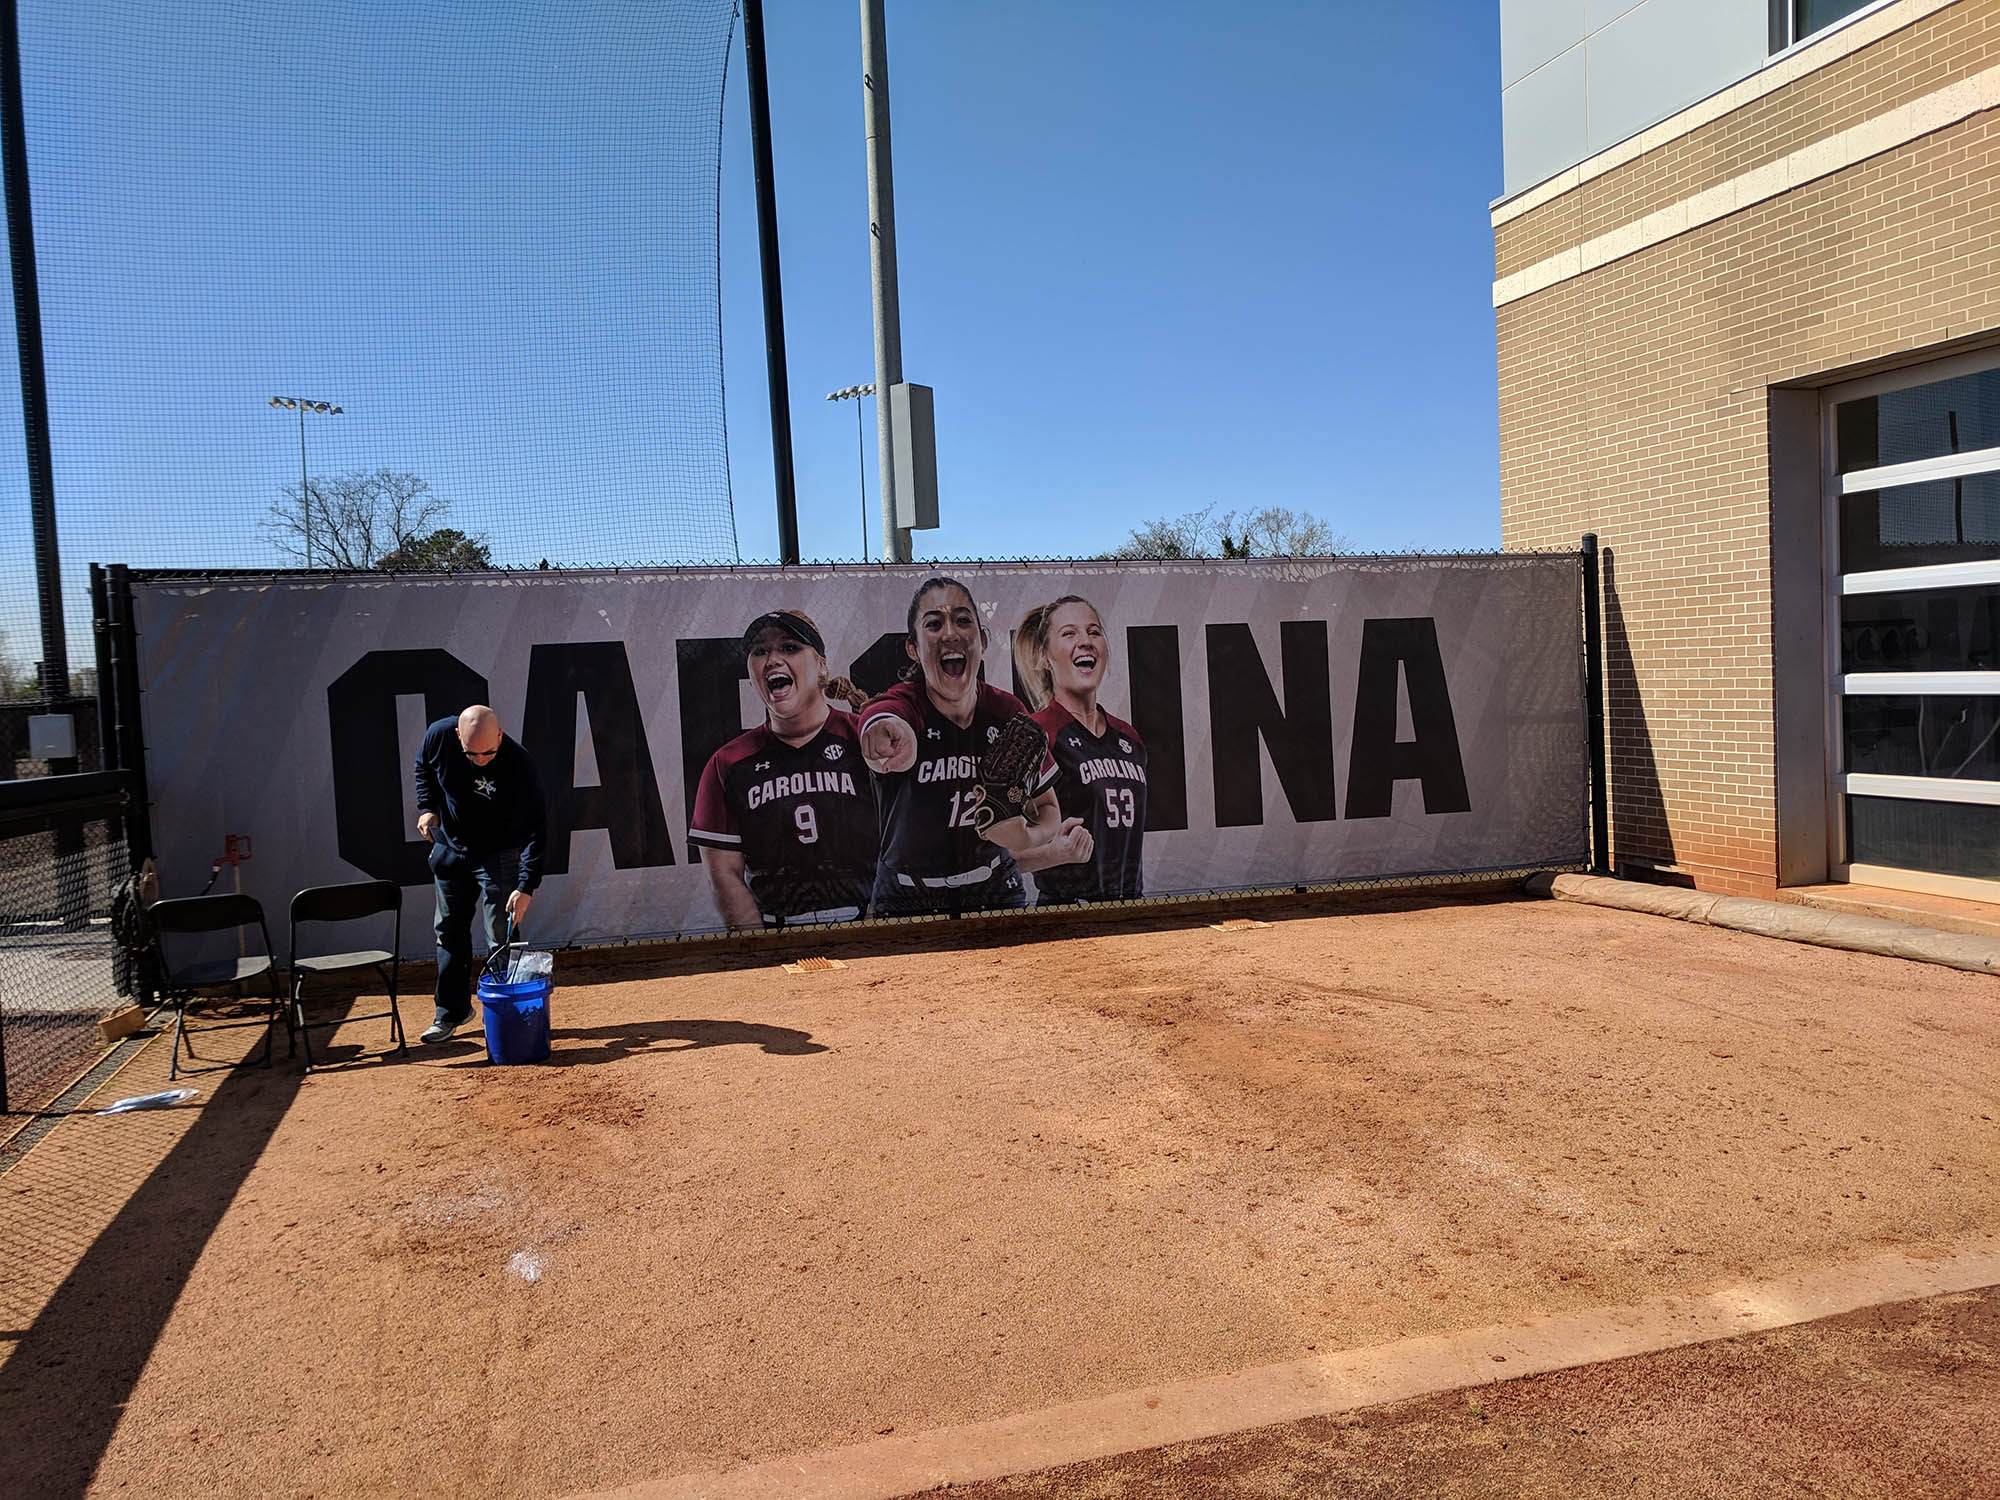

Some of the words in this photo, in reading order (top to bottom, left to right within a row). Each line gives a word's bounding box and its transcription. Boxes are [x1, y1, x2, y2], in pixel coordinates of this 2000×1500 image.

[328, 617, 1472, 886] CAINA
[823, 743, 845, 761] SEC
[748, 771, 857, 810] CAROLINA
[1079, 758, 1147, 787] CAROLINA
[794, 803, 819, 844] 9
[948, 791, 978, 828] 12
[1104, 788, 1135, 828] 53
